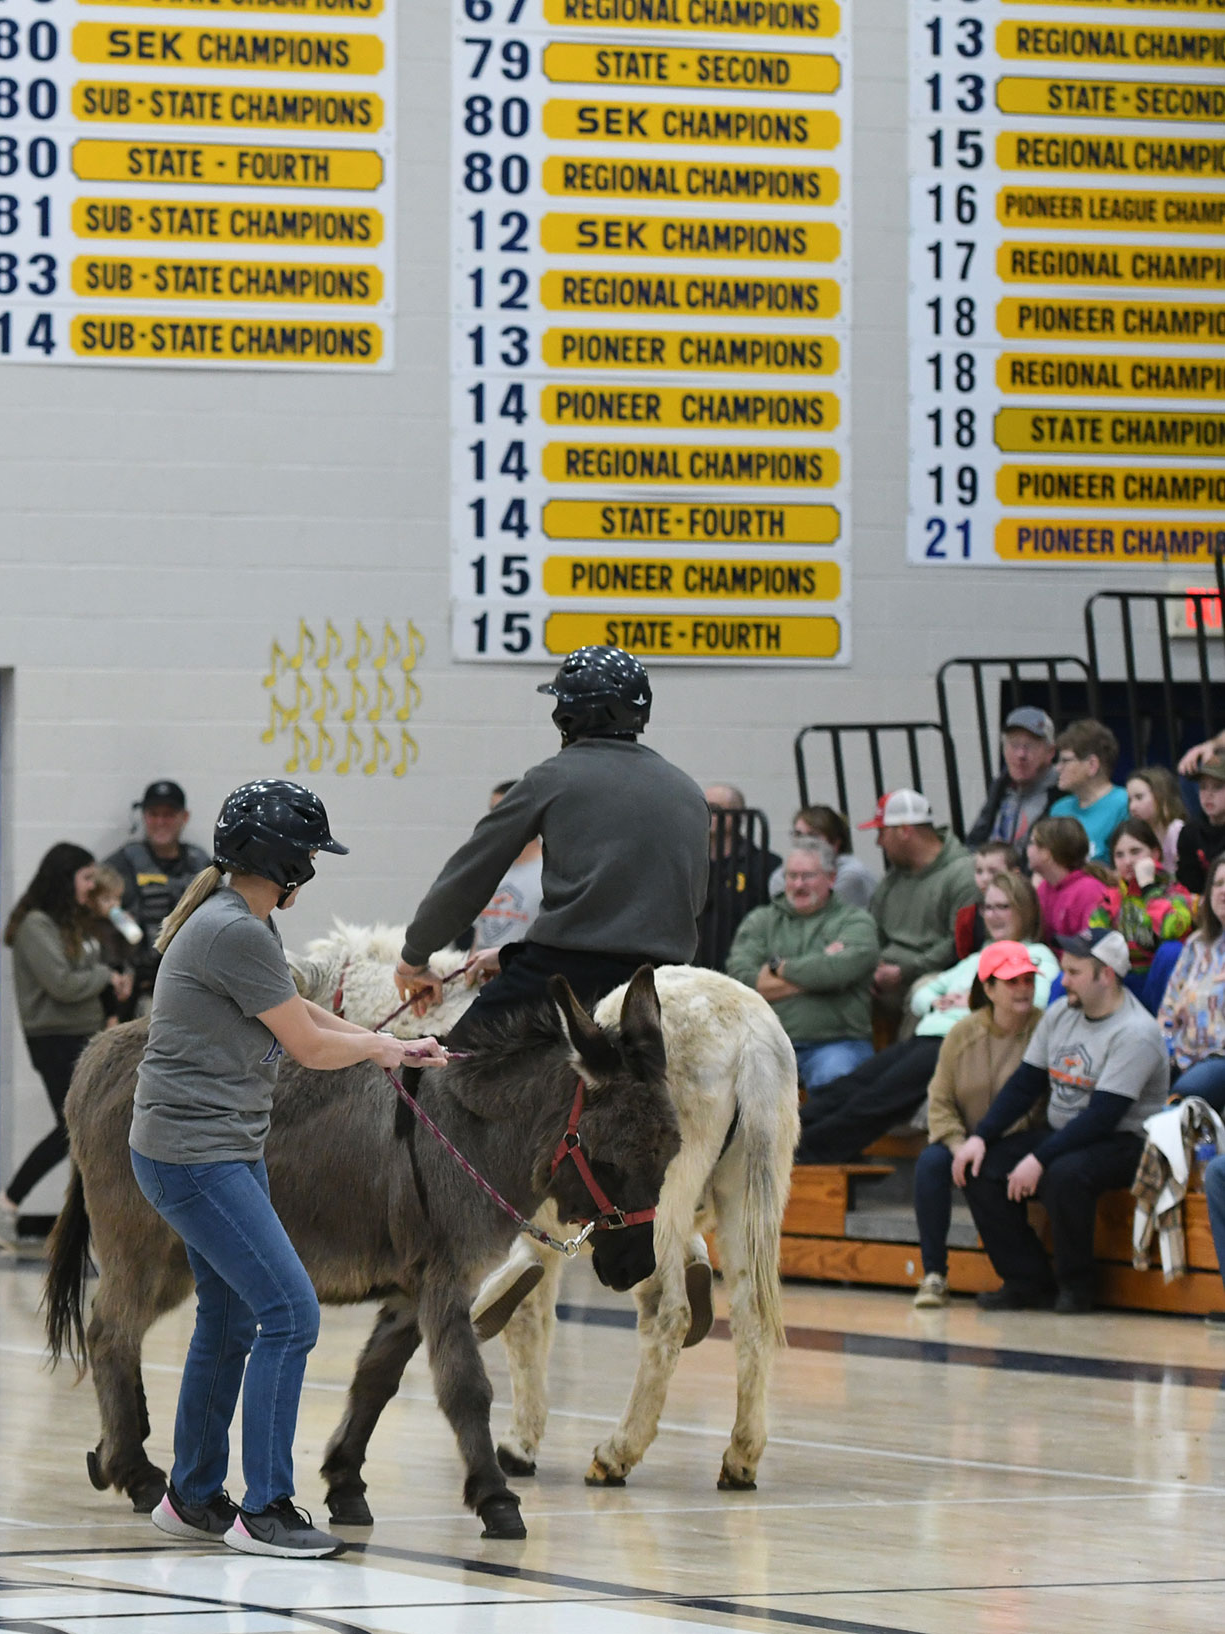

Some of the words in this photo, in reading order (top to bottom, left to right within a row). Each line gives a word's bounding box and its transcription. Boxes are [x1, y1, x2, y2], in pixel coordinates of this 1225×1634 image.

[565, 0, 681, 23] REGIONAL
[688, 0, 819, 30] CHAMPIONS
[109, 30, 182, 60] SEK
[199, 34, 349, 67] CHAMPIONS
[926, 17, 983, 58] 13
[1017, 27, 1130, 58] REGIONAL
[1135, 33, 1225, 61] CHAMPI
[464, 38, 530, 81] 79
[597, 51, 668, 80] STATE
[698, 55, 790, 85] SECOND
[231, 94, 371, 126] CHAMPIONS
[927, 73, 985, 113] 13
[1049, 84, 1115, 112] STATE
[1136, 88, 1225, 116] SECOND
[464, 95, 529, 138] 80
[578, 107, 647, 136] SEK
[663, 110, 808, 143] CHAMPIONS
[129, 148, 202, 177] STATE
[238, 152, 329, 181] FOURTH
[929, 129, 984, 169] 15
[1017, 138, 1128, 169] REGIONAL
[464, 152, 529, 195] 80
[564, 163, 680, 194] REGIONAL
[687, 168, 820, 199] CHAMPIONS
[928, 184, 976, 225] 16
[1006, 194, 1083, 219] PIONEER
[1089, 197, 1156, 222] LEAGUE
[231, 210, 370, 241] CHAMPIONS
[470, 210, 528, 252] 12
[578, 221, 646, 249] SEK
[663, 224, 806, 255] CHAMPIONS
[928, 241, 975, 280] 17
[1012, 250, 1123, 278] REGIONAL
[230, 267, 369, 298] CHAMPIONS
[469, 268, 528, 310] 12
[563, 277, 680, 308] REGIONAL
[686, 281, 819, 311] CHAMPIONS
[928, 297, 975, 337] 18
[1019, 305, 1115, 333] PIONEER
[231, 326, 371, 357] CHAMPIONS
[468, 325, 529, 367] 13
[562, 335, 665, 363] PIONEER
[680, 337, 822, 368] CHAMPIONS
[928, 352, 975, 393] 18
[1011, 361, 1122, 388] REGIONAL
[469, 382, 527, 424] 14
[557, 392, 660, 421] PIONEER
[682, 394, 823, 425] CHAMPIONS
[928, 408, 975, 448] 18
[1032, 416, 1102, 443] STATE
[470, 440, 528, 482] 14
[566, 449, 682, 478] REGIONAL
[690, 452, 822, 481] CHAMPIONS
[929, 466, 978, 506] 19
[1018, 472, 1115, 499] PIONEER
[470, 498, 529, 539] 14
[926, 518, 970, 558] 21
[1018, 528, 1114, 554] PIONEER
[472, 555, 530, 596] 15
[572, 563, 673, 591] PIONEER
[684, 565, 815, 594] CHAMPIONS
[474, 613, 531, 654] 15
